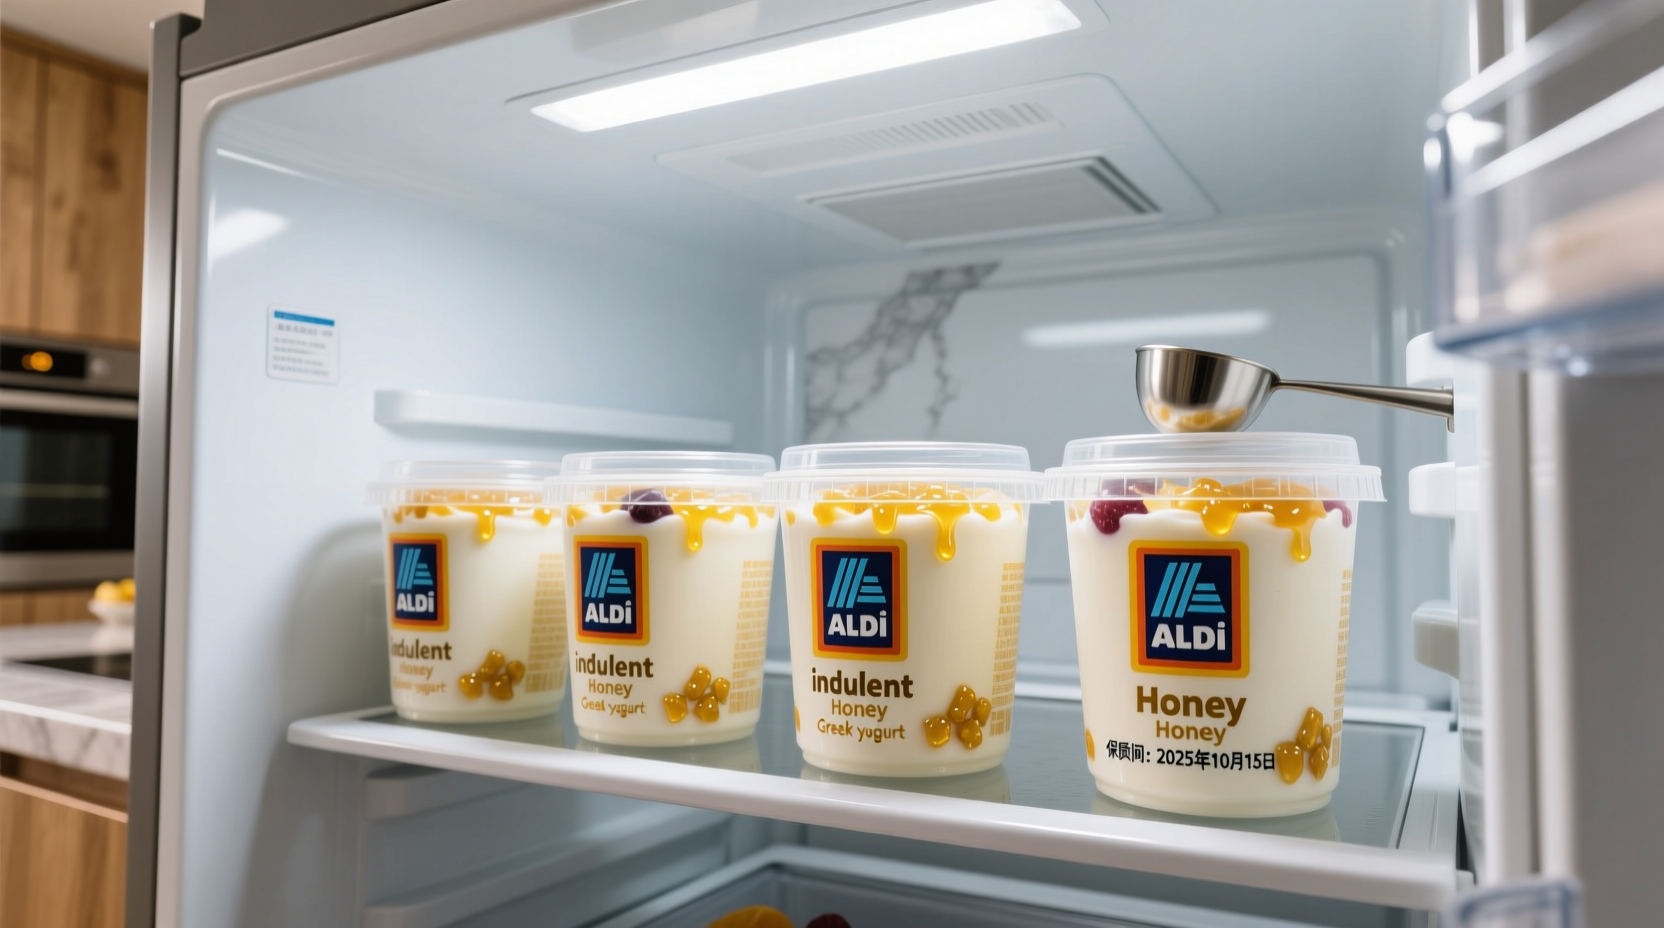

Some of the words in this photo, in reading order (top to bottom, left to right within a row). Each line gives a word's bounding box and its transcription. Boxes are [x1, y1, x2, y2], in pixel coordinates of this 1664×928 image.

[576, 651, 654, 678] indulent
[588, 678, 633, 699] Honey
[812, 667, 914, 699] indulent
[831, 698, 888, 723] Honey
[1136, 685, 1247, 727] Honey
[1155, 720, 1226, 746] Honey
